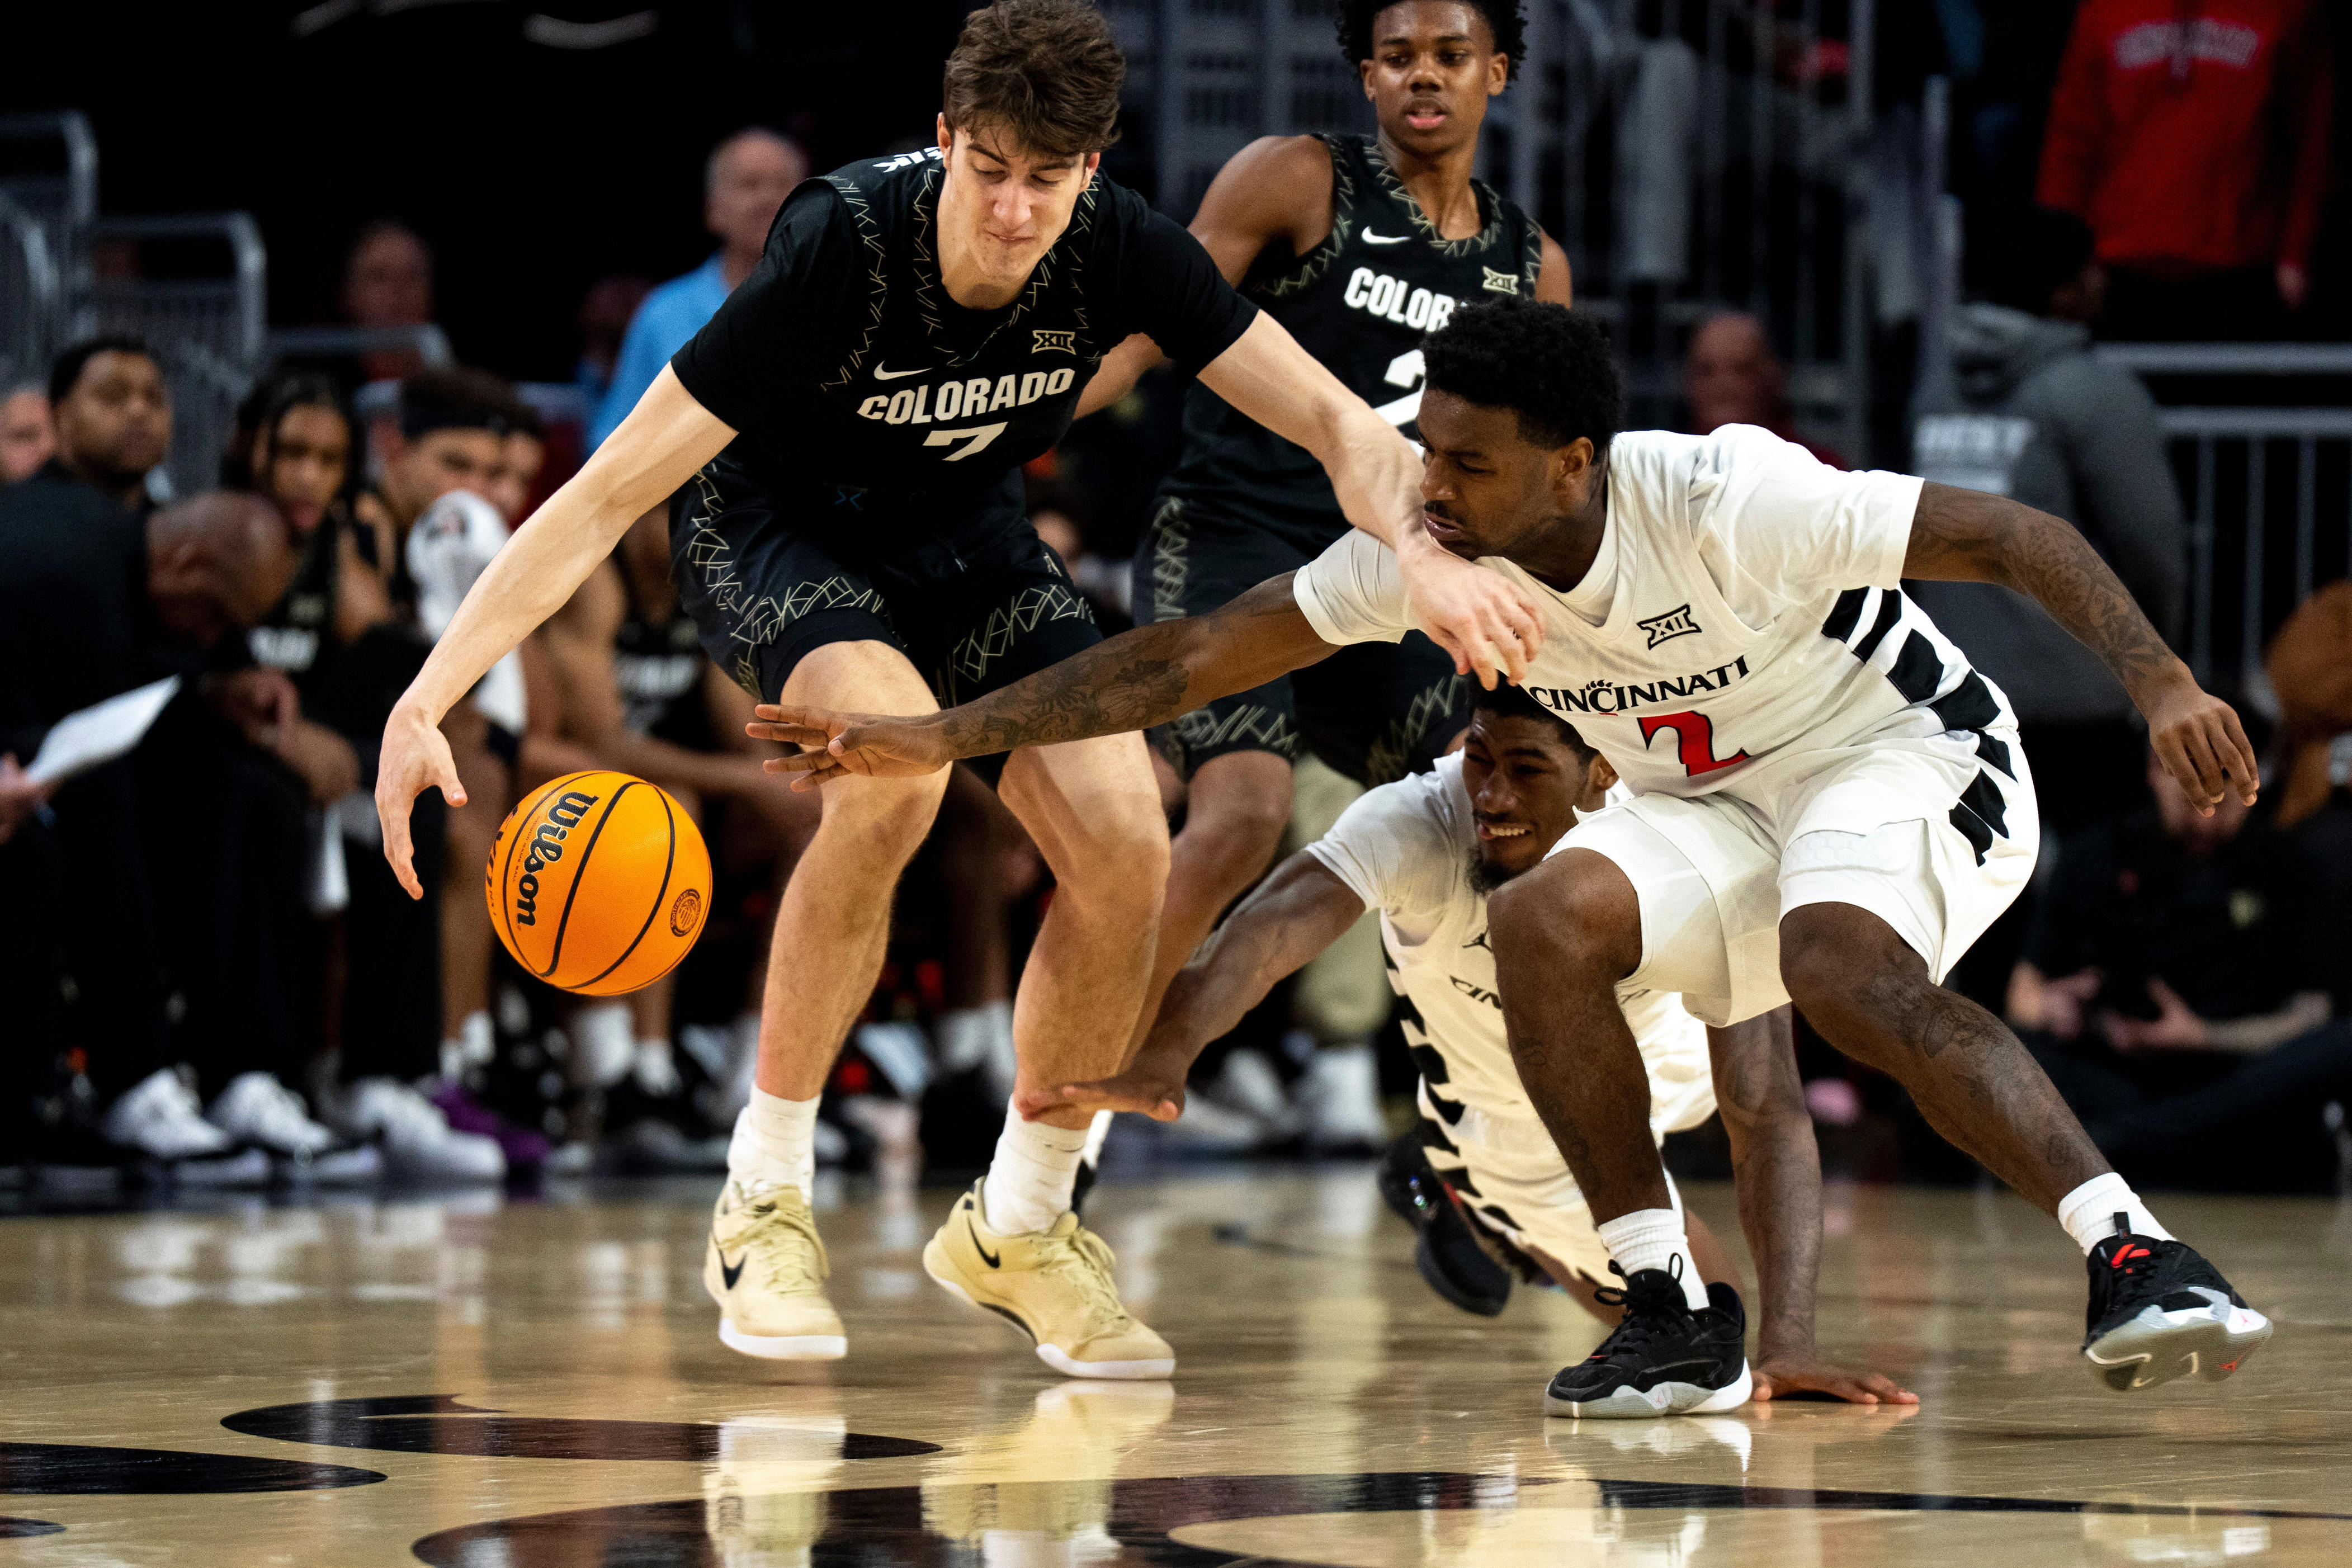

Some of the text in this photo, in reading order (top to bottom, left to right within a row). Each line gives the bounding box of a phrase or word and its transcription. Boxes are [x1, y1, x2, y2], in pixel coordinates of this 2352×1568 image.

[1344, 267, 1457, 333] COLOR
[857, 367, 1075, 425] COLORADO
[922, 422, 1008, 461] 7
[1529, 655, 1751, 713] CINCINNATI
[1637, 710, 1753, 778] 2
[517, 791, 600, 927] Wilson
